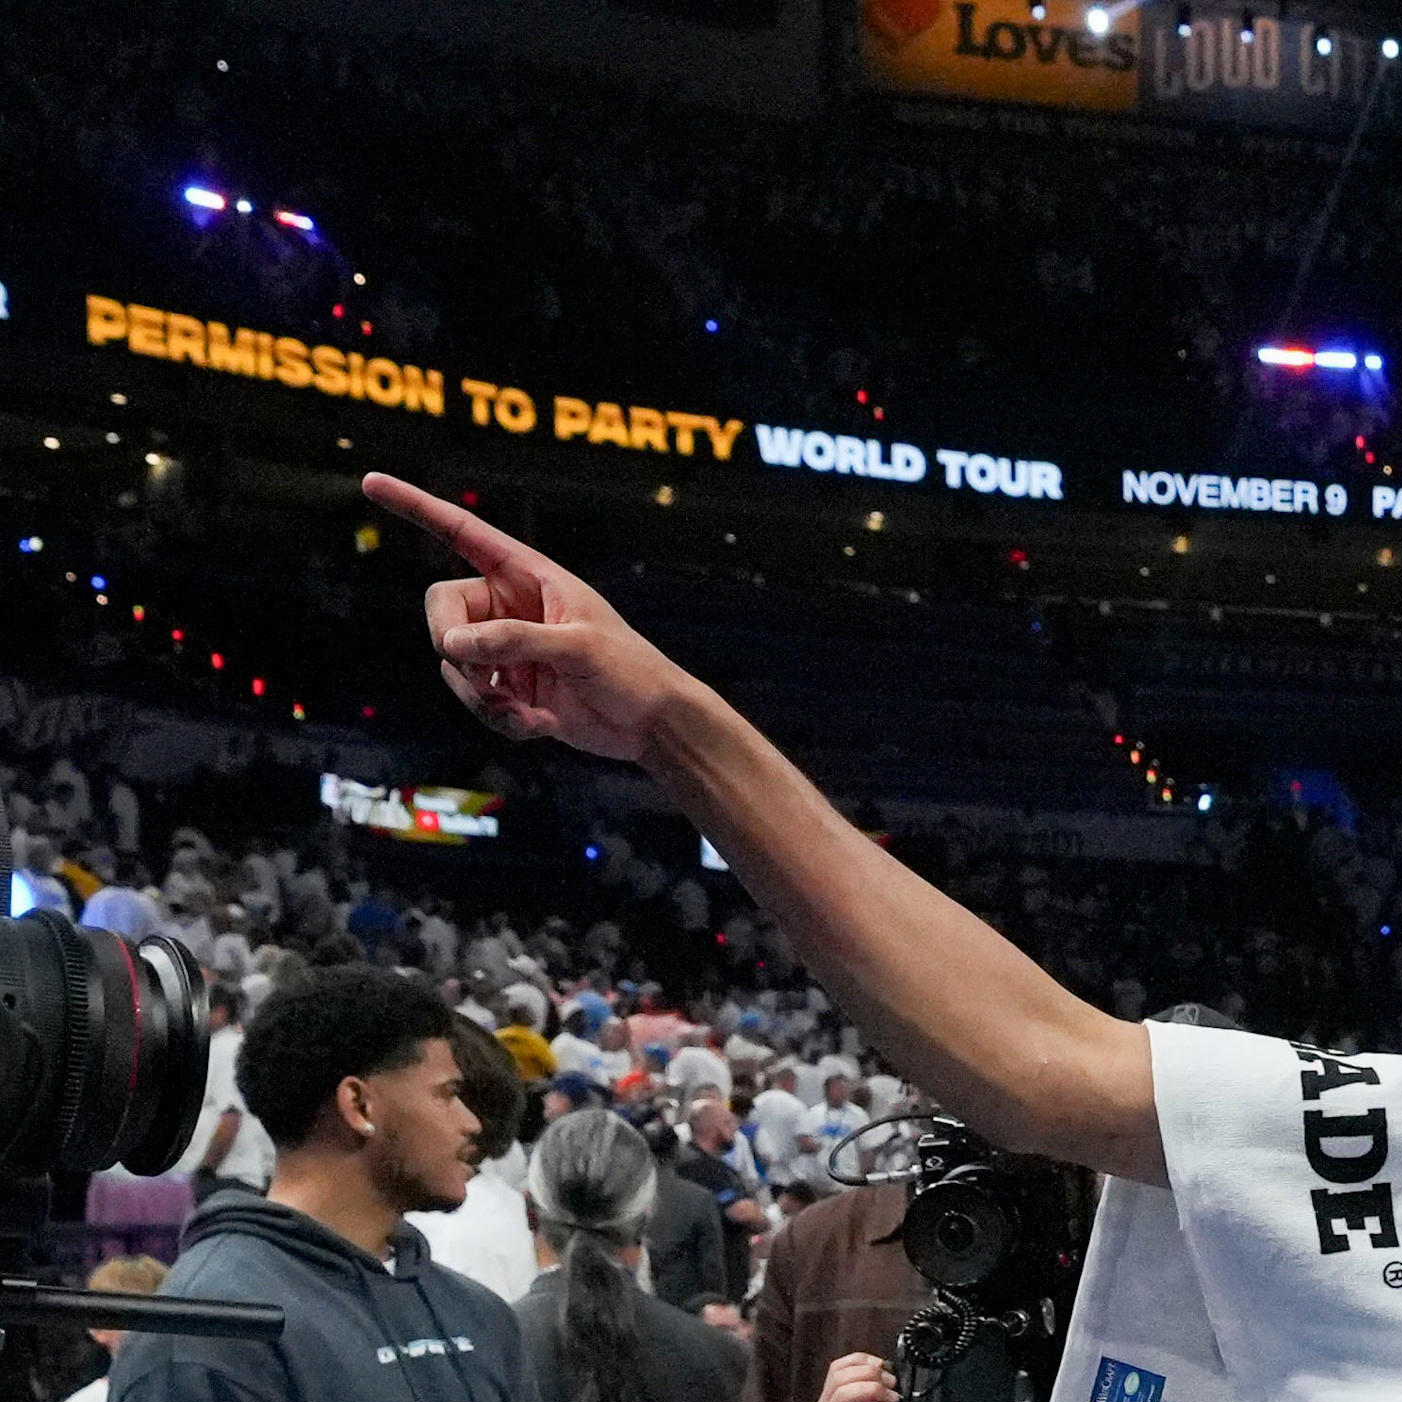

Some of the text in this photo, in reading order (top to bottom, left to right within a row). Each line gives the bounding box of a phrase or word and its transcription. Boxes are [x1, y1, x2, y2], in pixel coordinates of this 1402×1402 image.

[86, 294, 1063, 500] PERMISSION TO PARTY WORLD TOUR
[1122, 469, 1318, 515] NOVEMBER
[1325, 484, 1348, 515] 9
[1297, 1048, 1400, 1255] ADE
